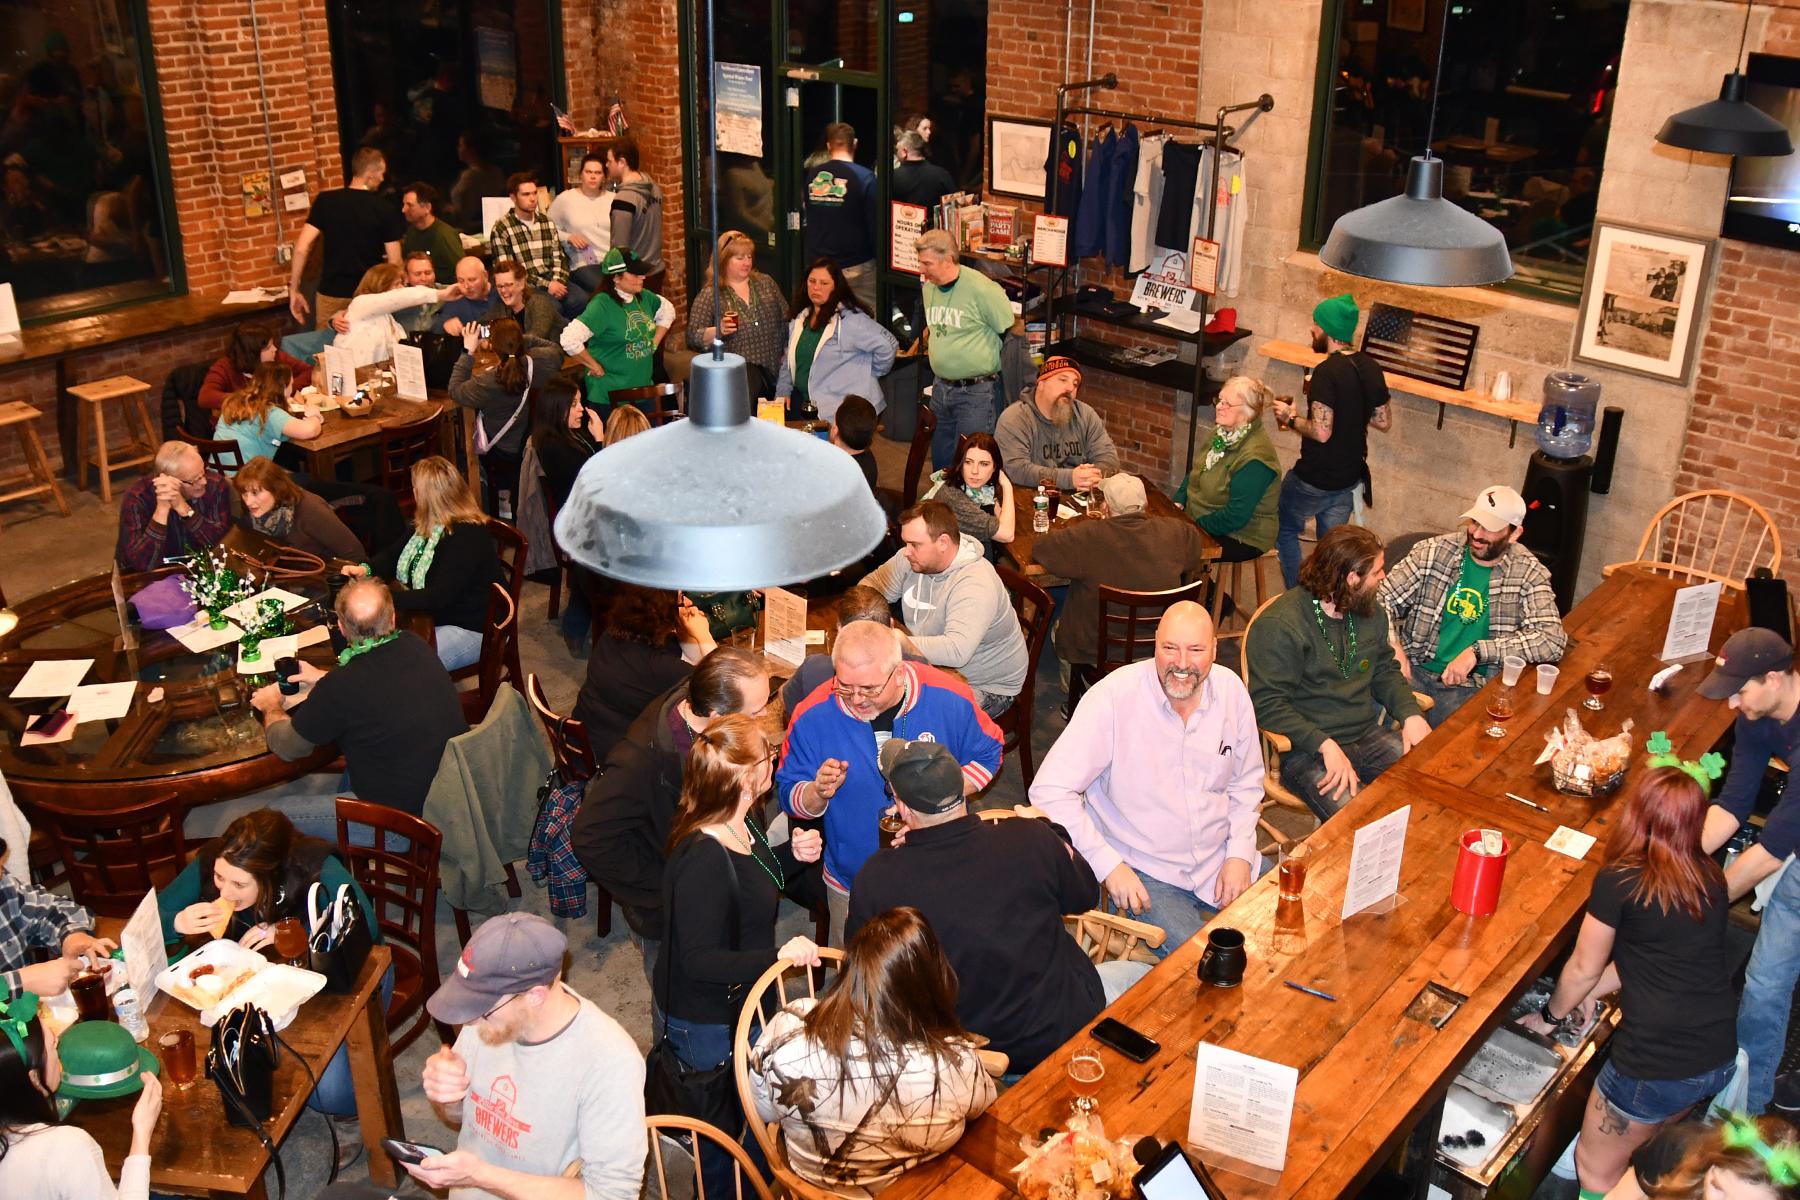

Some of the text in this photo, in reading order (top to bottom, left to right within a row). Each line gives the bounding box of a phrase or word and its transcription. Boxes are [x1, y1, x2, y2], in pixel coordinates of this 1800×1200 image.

[990, 222, 1011, 230] PARTY
[990, 228, 1011, 236] GAME
[1143, 281, 1187, 304] BREWERS
[926, 305, 964, 328] LUCKY
[475, 1106, 520, 1150] BREWERS
